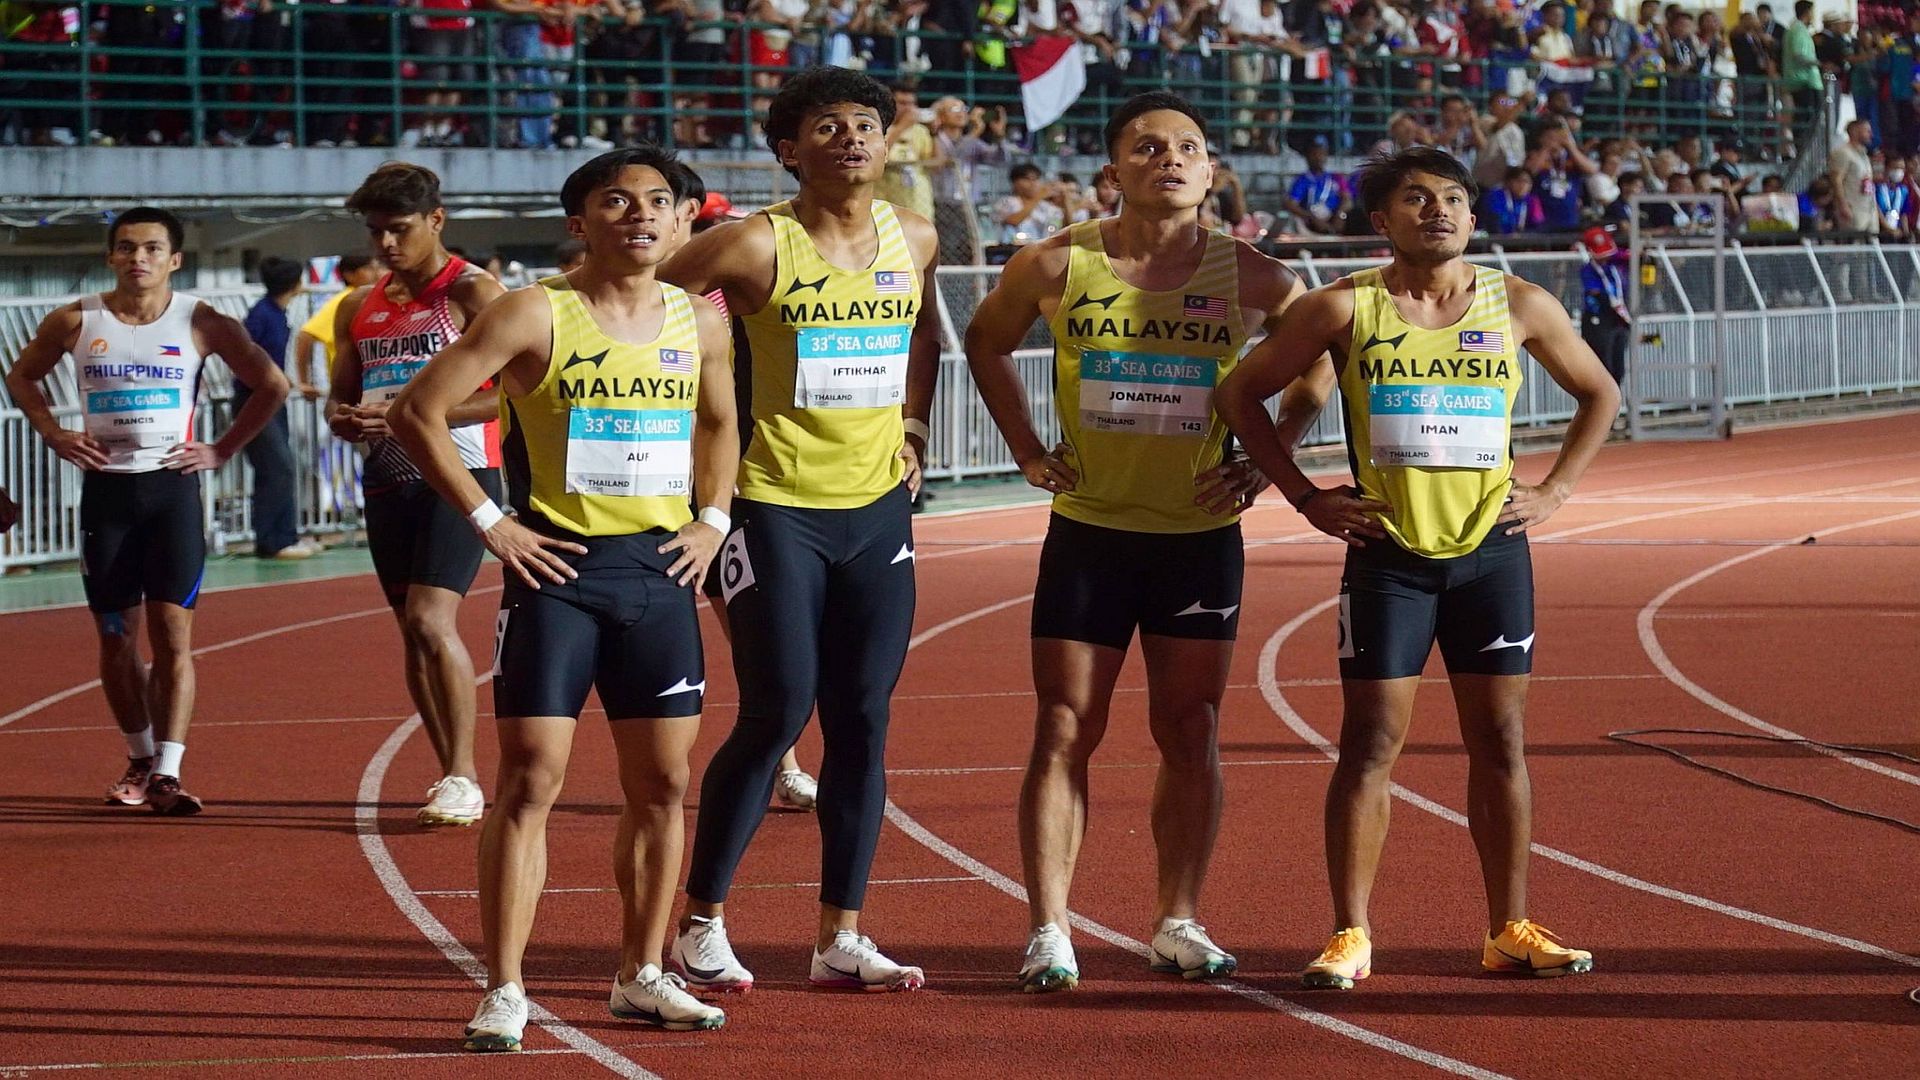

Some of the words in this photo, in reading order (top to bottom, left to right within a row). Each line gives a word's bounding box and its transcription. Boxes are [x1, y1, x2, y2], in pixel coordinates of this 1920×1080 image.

[780, 299, 914, 324] MALAYSIA
[1067, 317, 1232, 346] MALAYSIA
[359, 331, 440, 362] SINGAPORE
[811, 332, 836, 352] 33rd
[836, 336, 861, 351] SEA
[864, 333, 903, 351] GAMES
[83, 363, 185, 380] PHILIPPINES
[833, 366, 887, 377] IFTIKHAR
[1095, 356, 1120, 374] 33rd
[1120, 360, 1147, 376] SEA
[1152, 362, 1202, 379] GAMES
[1358, 358, 1510, 380] MALAYSIA
[558, 377, 693, 400] MALAYSIA
[134, 392, 171, 406] GAMES
[814, 394, 853, 402] THAILAND
[1109, 391, 1182, 404] JONATHAN
[1384, 389, 1409, 408] 33rd
[1411, 393, 1440, 408] SEA
[1443, 394, 1492, 410] GAMES
[113, 417, 155, 427] FRANCIS
[585, 414, 612, 433] 33rd
[614, 418, 642, 434] SEA
[644, 418, 680, 434] GAMES
[1097, 416, 1136, 426] THAILAND
[1180, 421, 1201, 431] 143
[1420, 424, 1459, 435] IMAN
[1389, 451, 1430, 459] THAILAND
[1475, 453, 1496, 462] 304
[587, 479, 631, 489] THAILAND
[668, 480, 684, 490] 133
[723, 543, 745, 590] 6
